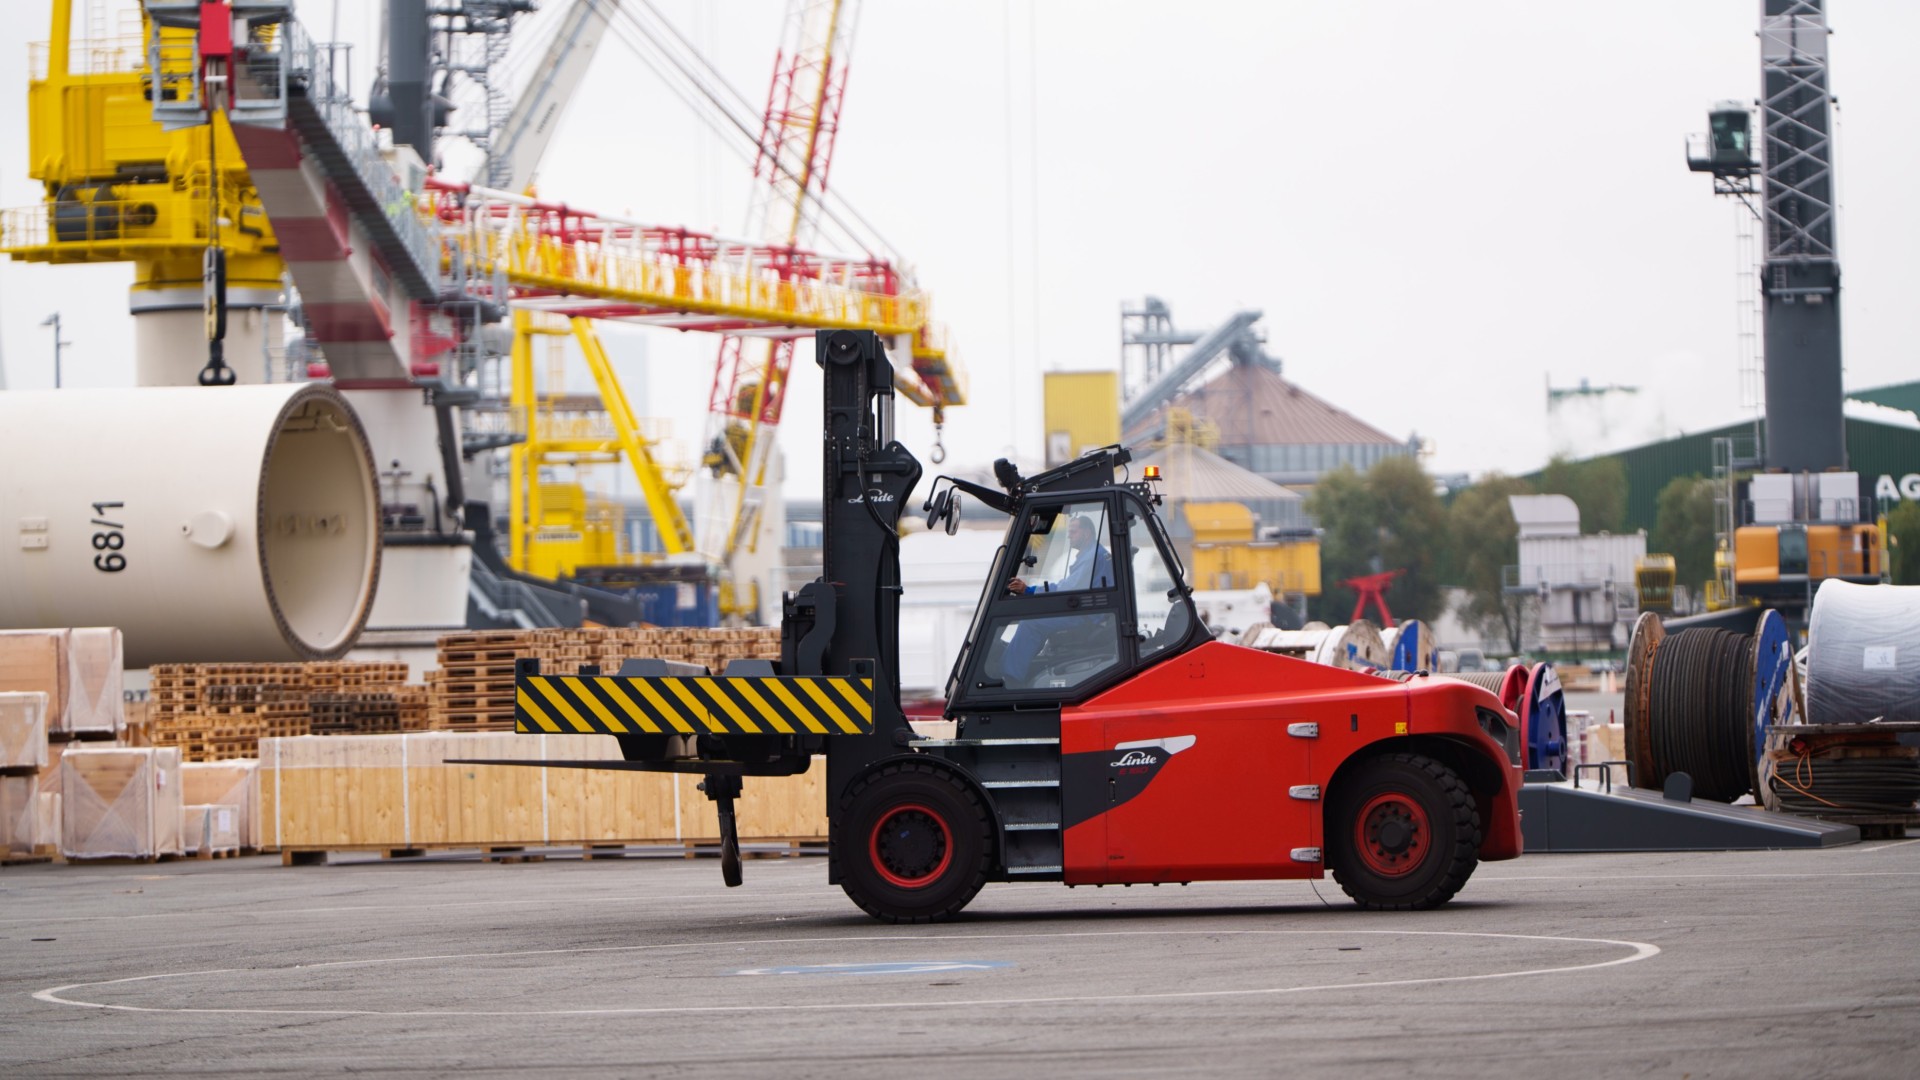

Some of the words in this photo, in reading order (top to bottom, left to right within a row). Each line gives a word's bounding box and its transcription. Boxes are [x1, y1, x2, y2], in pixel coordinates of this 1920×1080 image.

[848, 488, 894, 503] Lnde
[1876, 473, 1920, 500] AG
[91, 502, 127, 572] 68/1
[1110, 751, 1157, 767] Linde
